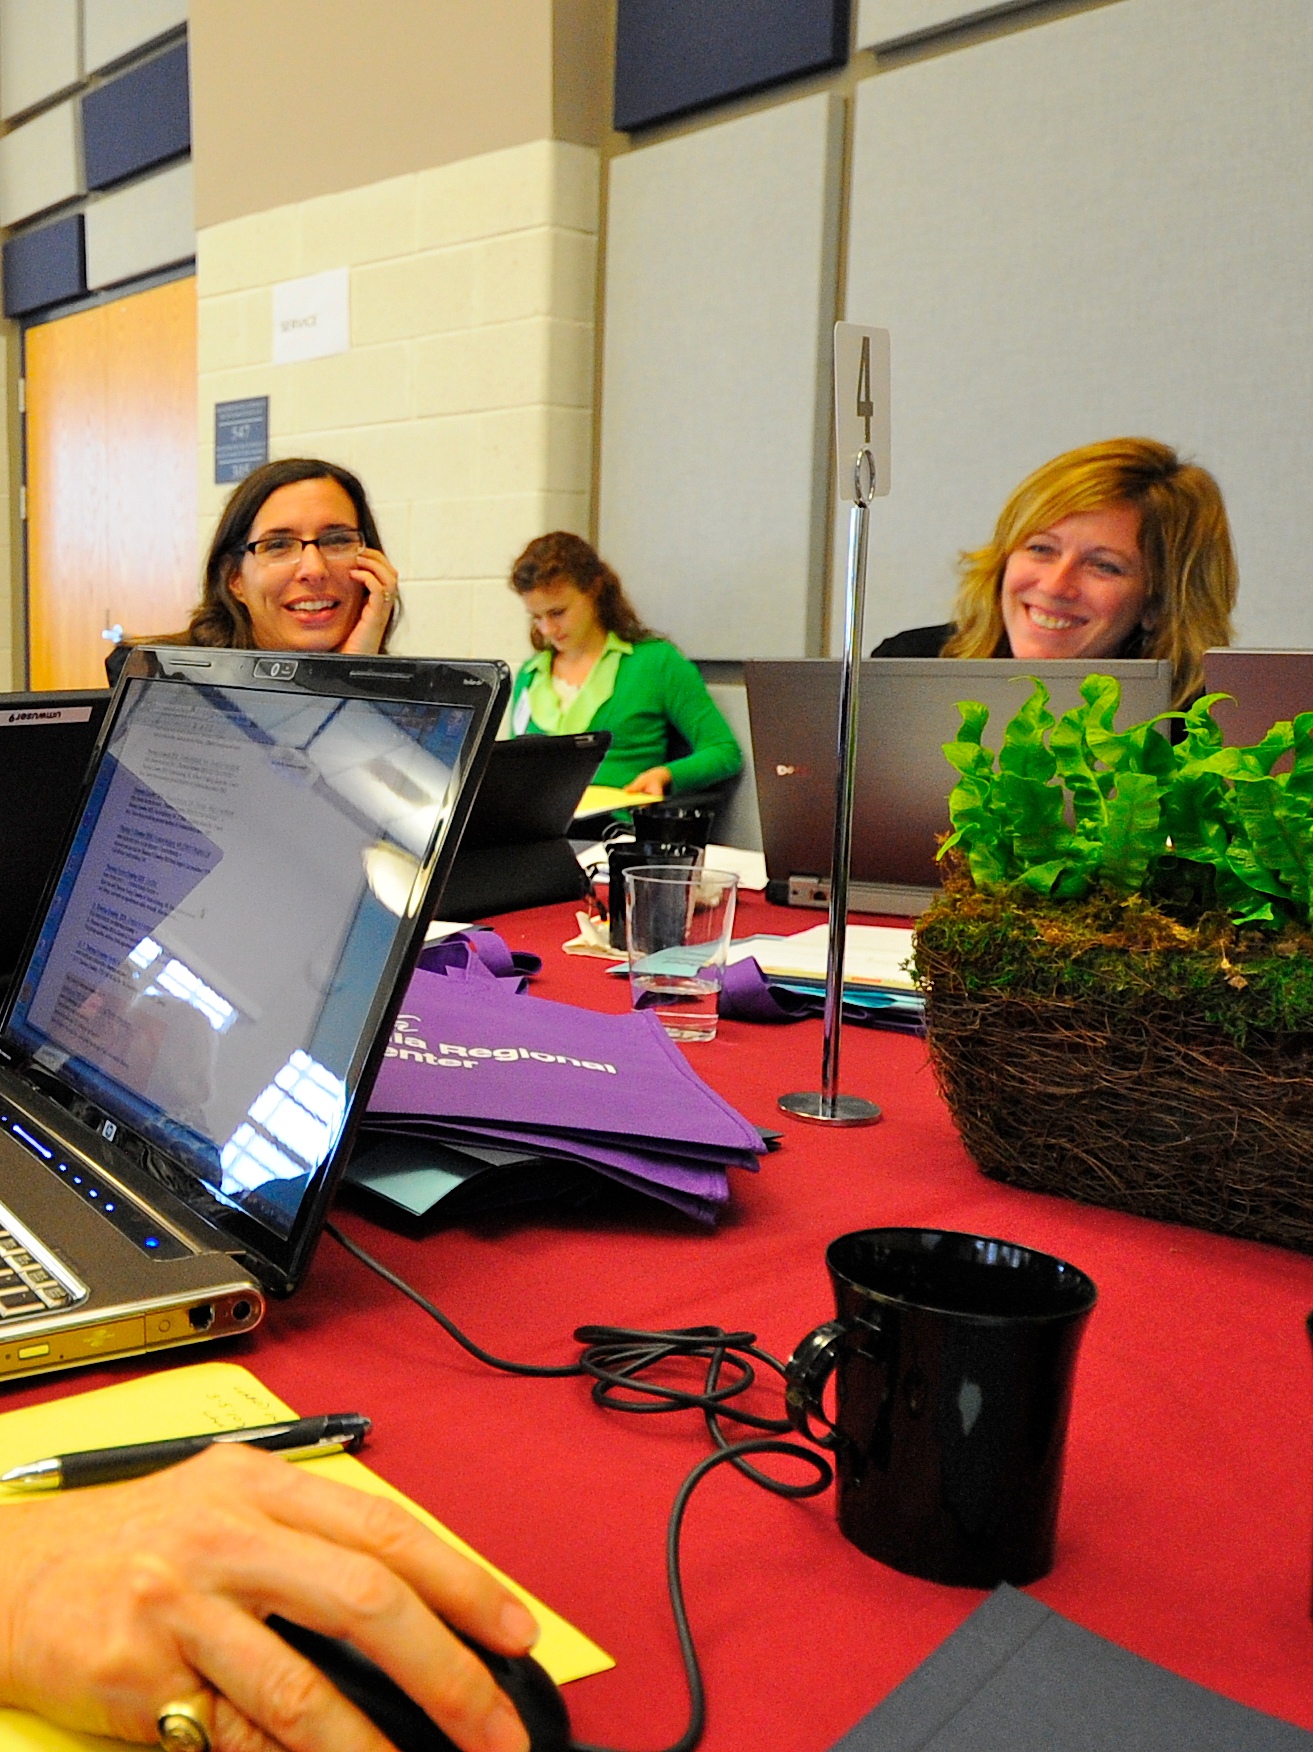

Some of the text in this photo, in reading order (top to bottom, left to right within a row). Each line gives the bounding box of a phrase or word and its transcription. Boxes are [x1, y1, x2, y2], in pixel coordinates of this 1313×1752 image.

[856, 336, 874, 444] 4
[8, 711, 62, 723] umwuser9
[383, 1045, 479, 1069] enter
[438, 1042, 618, 1075] Regional
